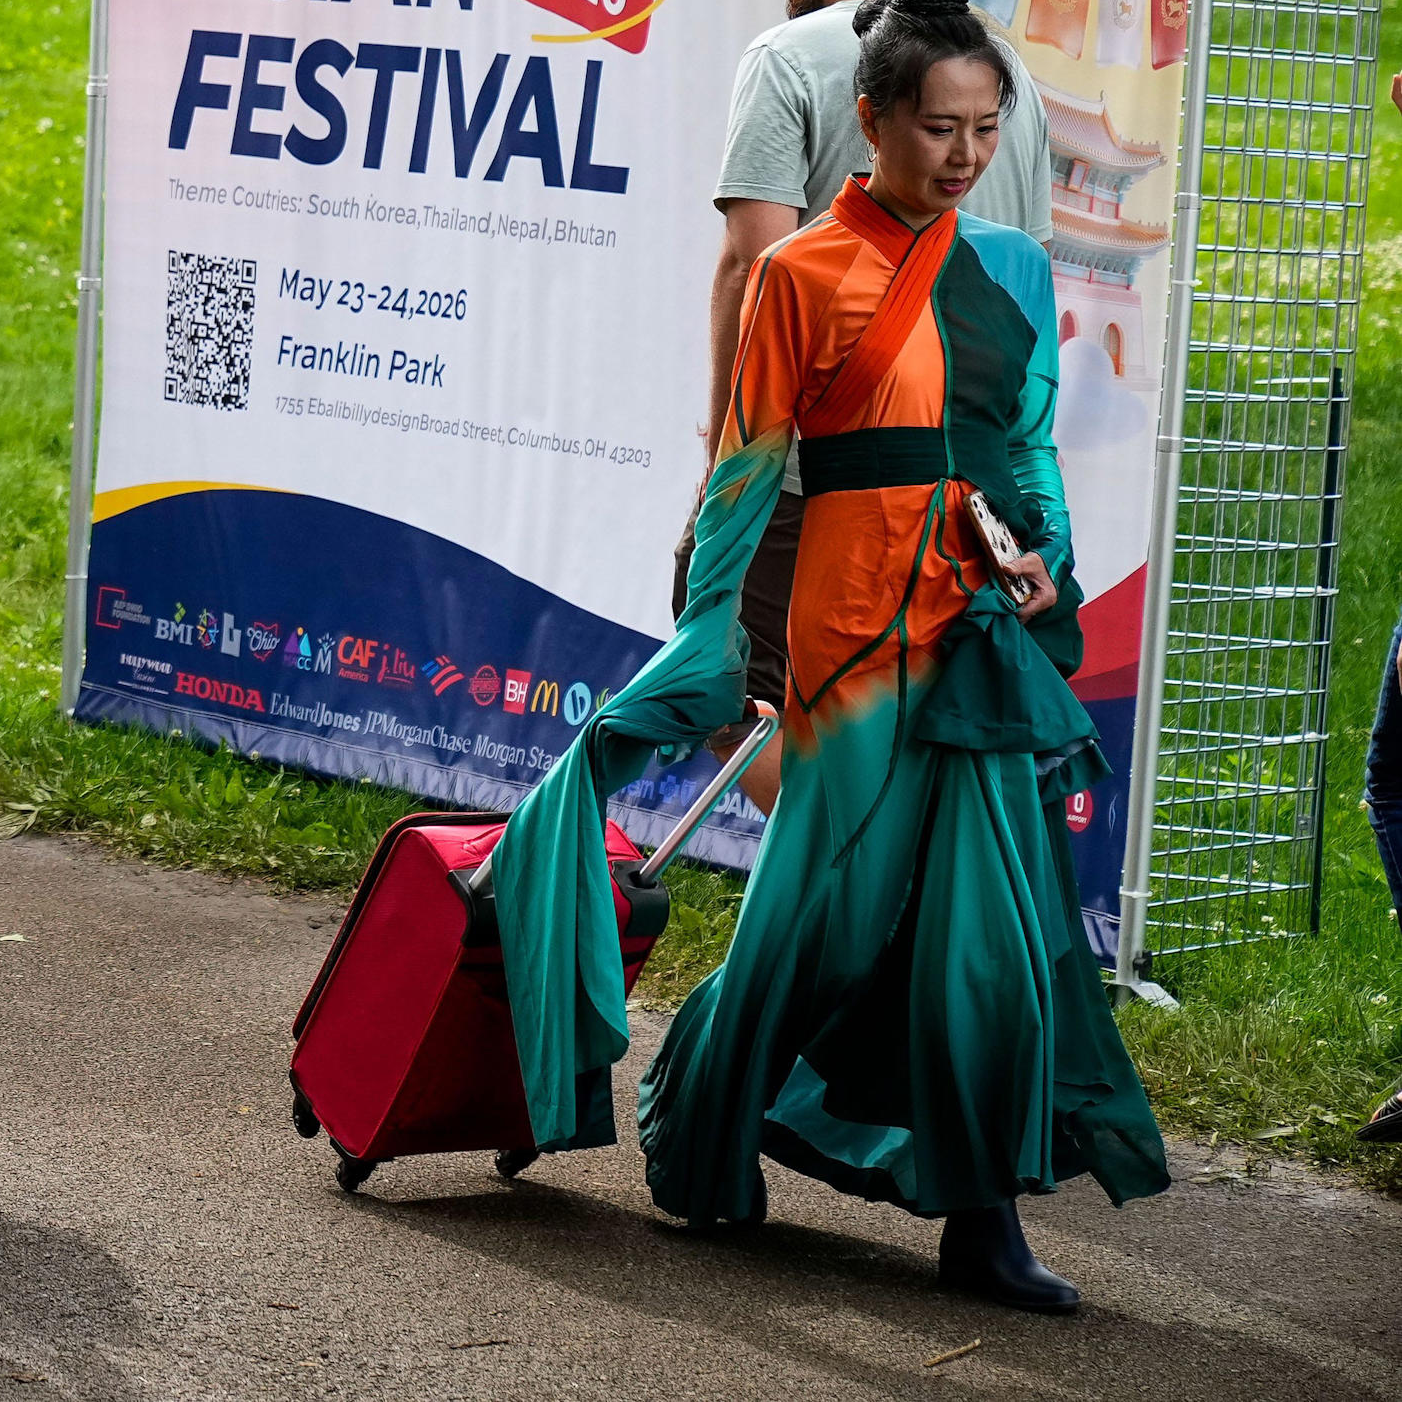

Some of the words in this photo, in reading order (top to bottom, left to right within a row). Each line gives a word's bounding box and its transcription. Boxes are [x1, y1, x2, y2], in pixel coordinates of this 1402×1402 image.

[168, 29, 630, 195] FESTIVAL
[169, 178, 227, 205] Theme
[232, 185, 303, 214] Coutries:
[307, 194, 360, 219] South
[279, 267, 333, 310] May
[337, 280, 468, 321] 23-24,2026
[277, 335, 380, 379] Franklin
[388, 350, 446, 388] Park
[275, 396, 304, 416] 1755
[609, 445, 652, 468] 43203
[155, 618, 195, 646] BMI
[247, 627, 281, 652] Ohio
[337, 635, 378, 669] CAF
[175, 672, 266, 712] HONDA
[338, 667, 370, 683] America
[506, 679, 529, 704] BH
[363, 709, 472, 754] JPMorganChase
[474, 733, 526, 768] Morgan
[1066, 814, 1088, 824] AIRPORT
